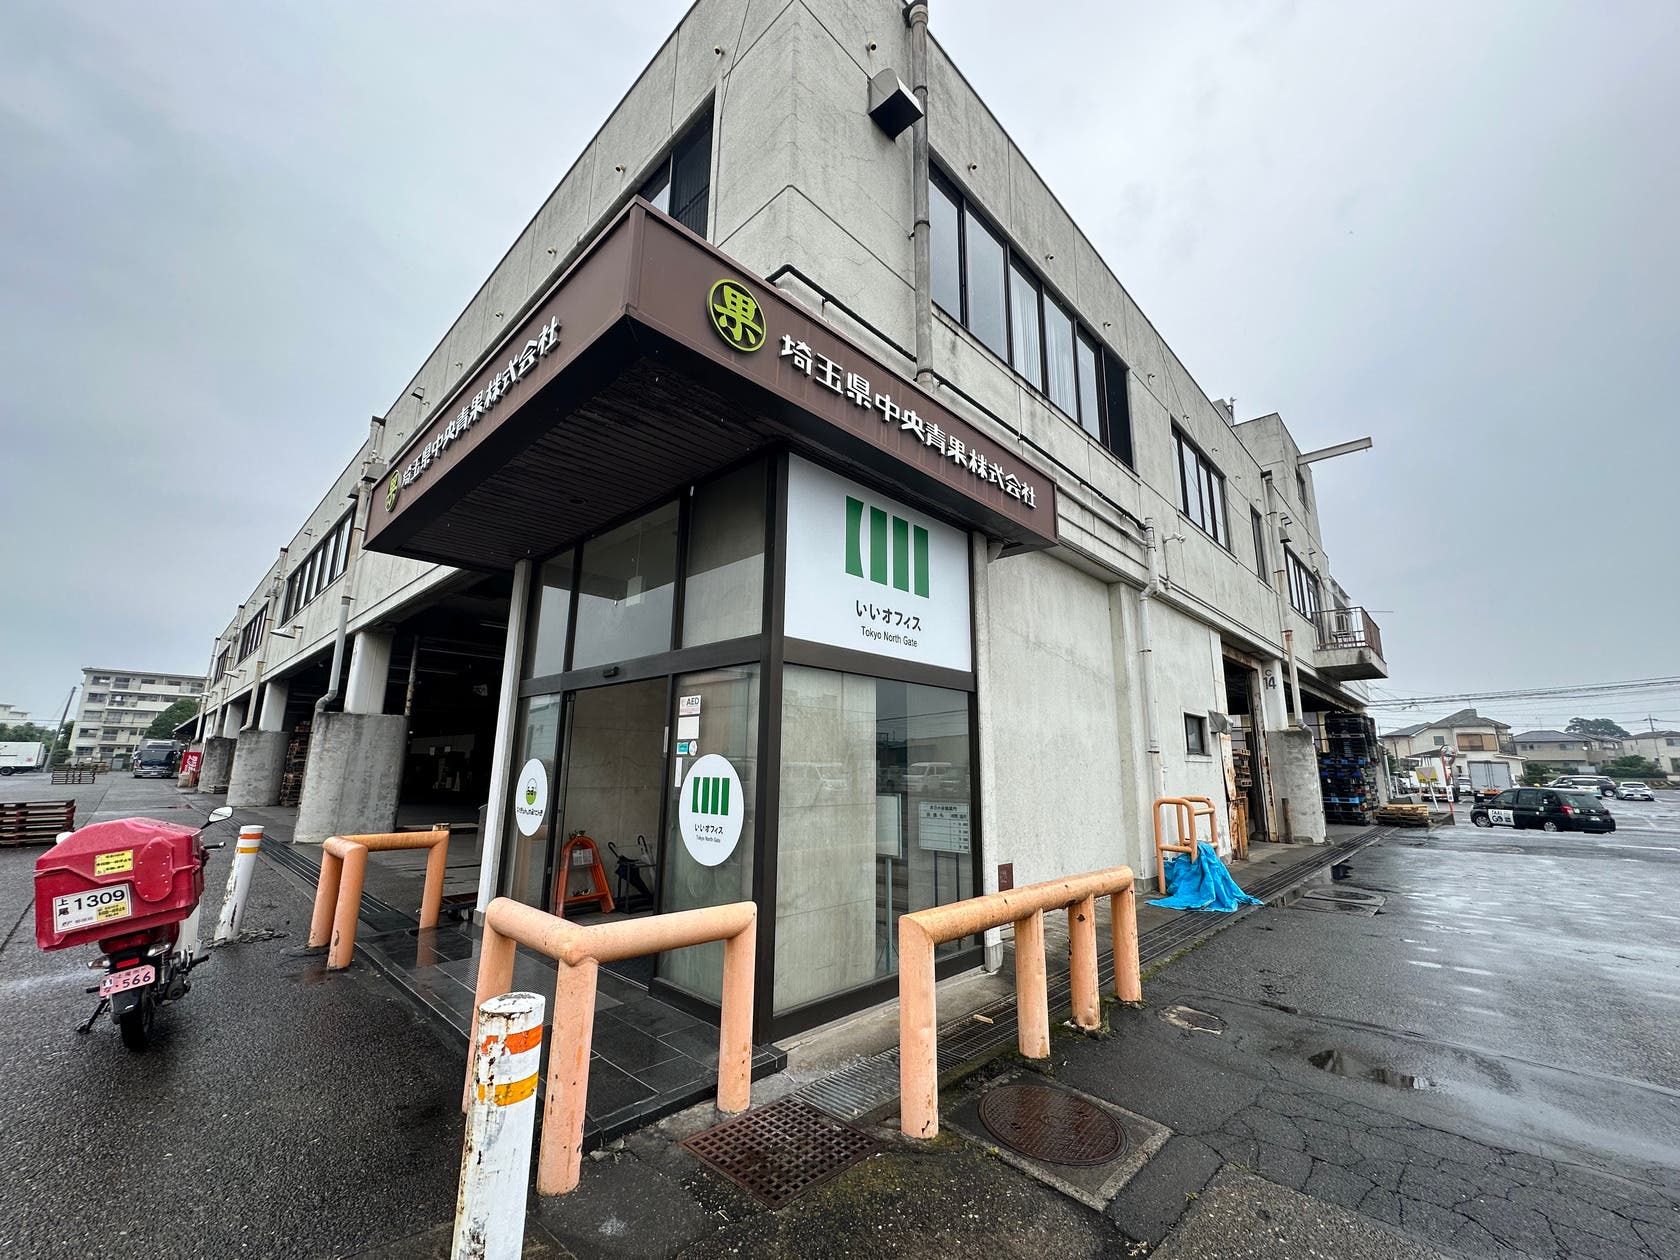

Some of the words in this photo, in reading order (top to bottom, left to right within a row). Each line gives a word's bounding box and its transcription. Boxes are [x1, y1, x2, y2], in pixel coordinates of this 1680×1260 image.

[713, 284, 764, 345] 果
[401, 315, 562, 489] 埼玉県中央青果株式会社
[779, 333, 1037, 509] 埼玉県中央青果株式会社
[856, 599, 921, 631] いいオフィス
[861, 626, 882, 640] Tokyo
[883, 631, 902, 643] North
[903, 636, 918, 647] Gate
[1263, 676, 1276, 689] 14
[687, 697, 700, 705] AED
[694, 823, 724, 835] いいオフィス
[75, 890, 125, 910] 1309
